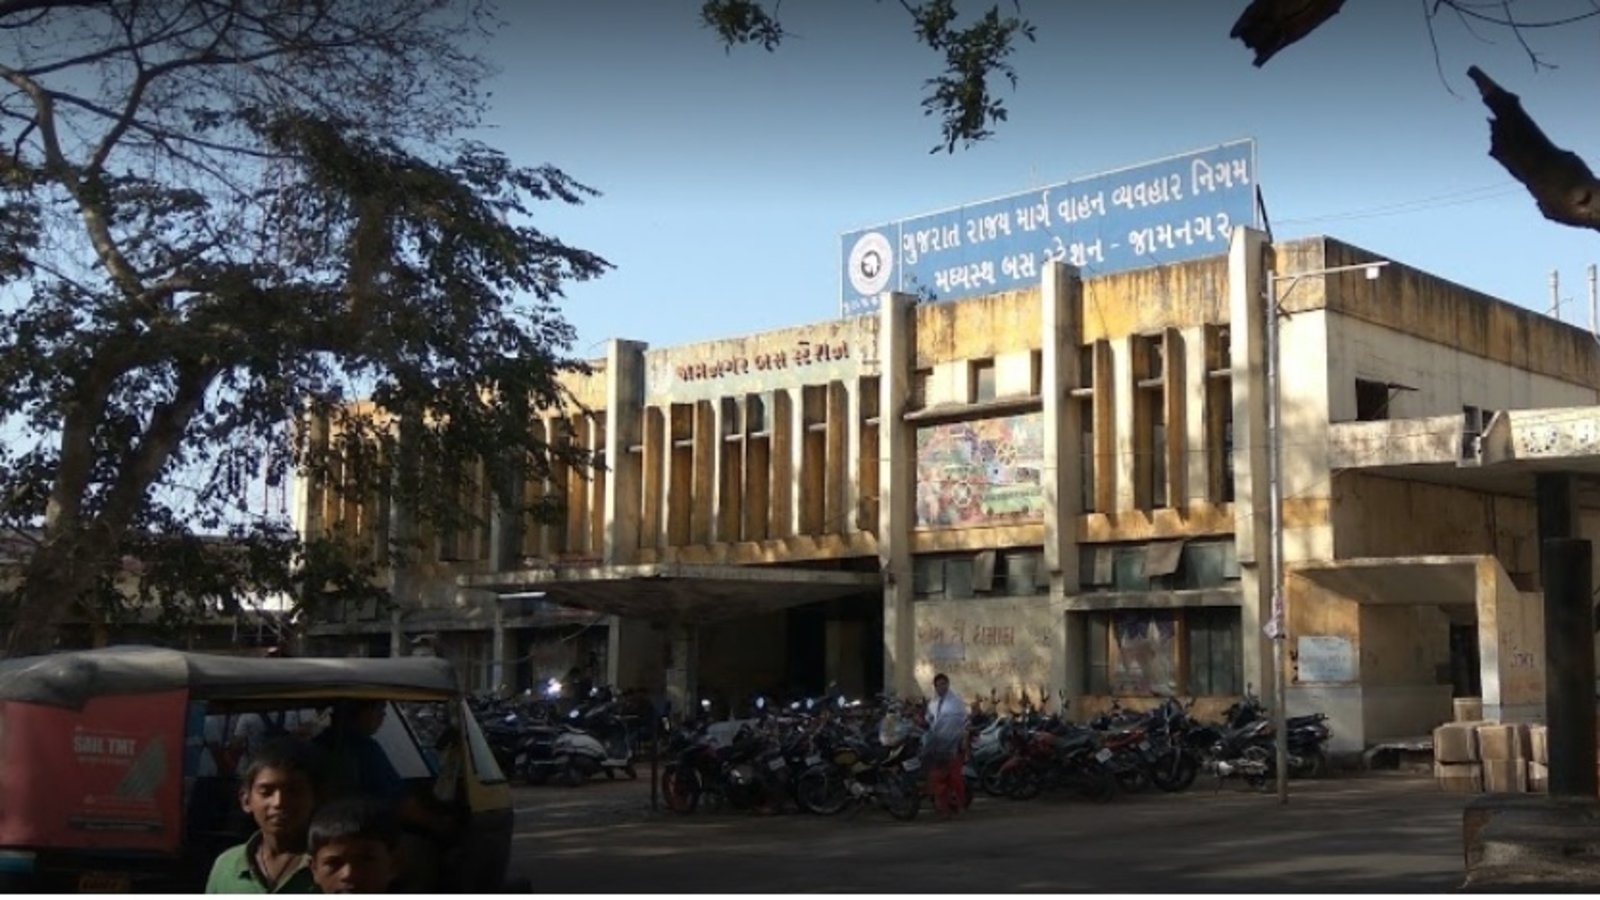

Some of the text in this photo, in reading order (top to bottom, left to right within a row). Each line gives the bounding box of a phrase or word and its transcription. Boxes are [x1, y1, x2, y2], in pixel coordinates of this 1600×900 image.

[903, 223, 960, 265] ગુજરાત
[1015, 190, 1051, 232] માર્ગ
[1057, 190, 1106, 223] વાહન
[1111, 173, 1184, 210] વ્યવહાર
[1191, 158, 1249, 195] નિગમ
[1001, 252, 1036, 280] બસ
[1128, 211, 1232, 256] જામનગર
[754, 350, 788, 371] બસ
[73, 735, 138, 756] SAIL TMT
